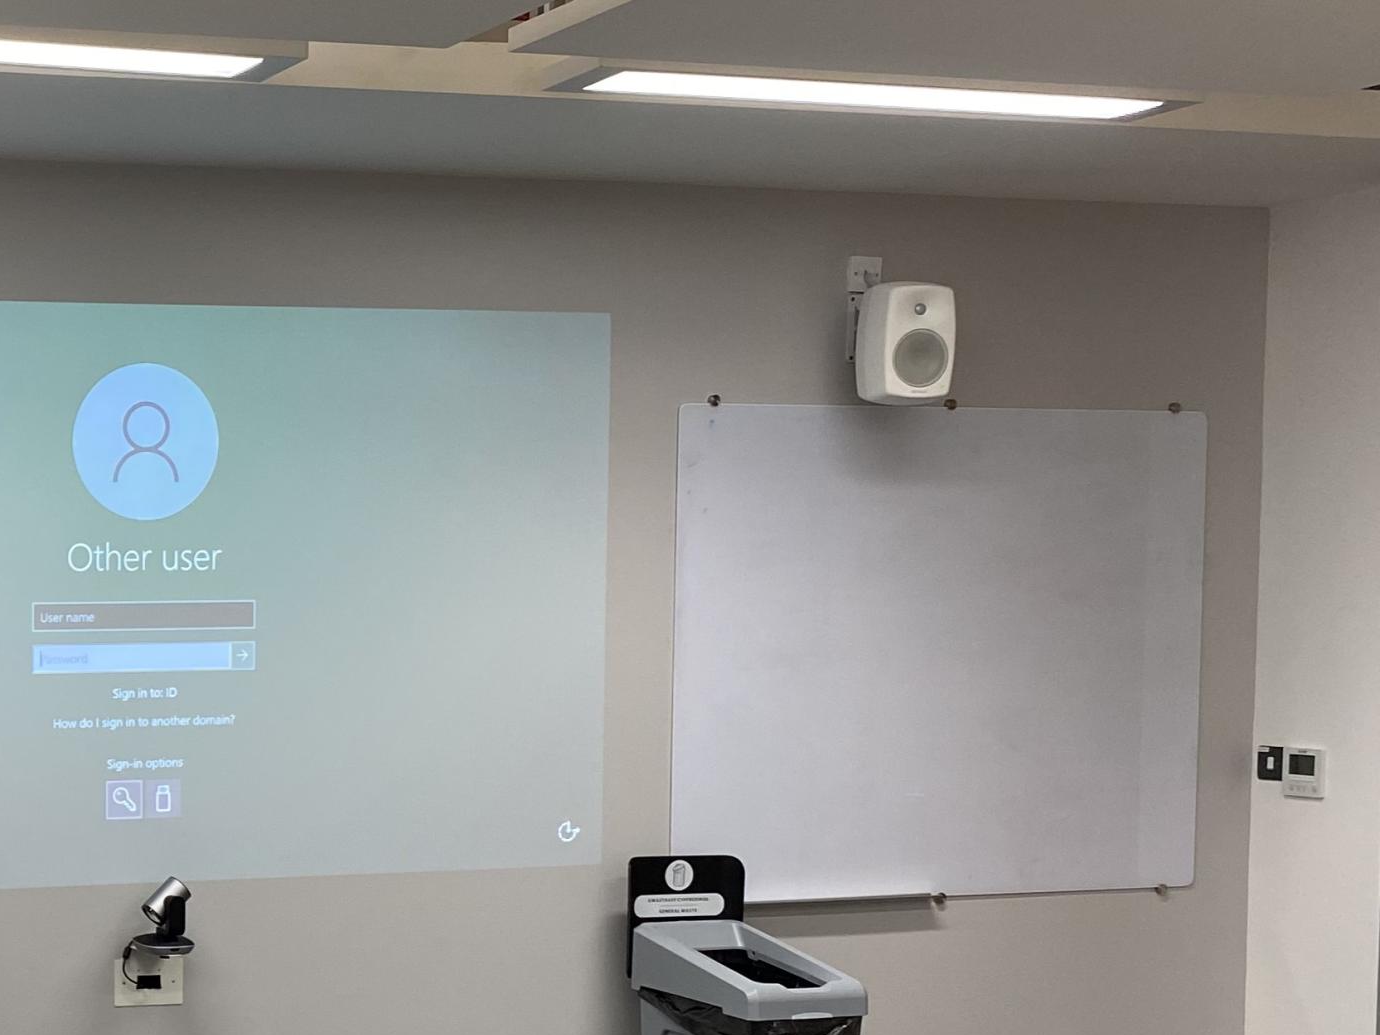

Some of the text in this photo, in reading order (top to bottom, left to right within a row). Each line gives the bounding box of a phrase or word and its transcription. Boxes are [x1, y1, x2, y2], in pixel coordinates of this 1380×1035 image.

[67, 541, 223, 573] Other user
[40, 612, 95, 624] User name
[112, 686, 178, 701] Sign in to: ID
[52, 718, 77, 729] How
[79, 717, 93, 729] do
[101, 716, 123, 731] sign
[125, 716, 136, 728] in
[138, 716, 149, 727] to
[151, 714, 191, 727] another
[193, 713, 236, 726] domain?
[107, 757, 184, 772] Sign-in options
